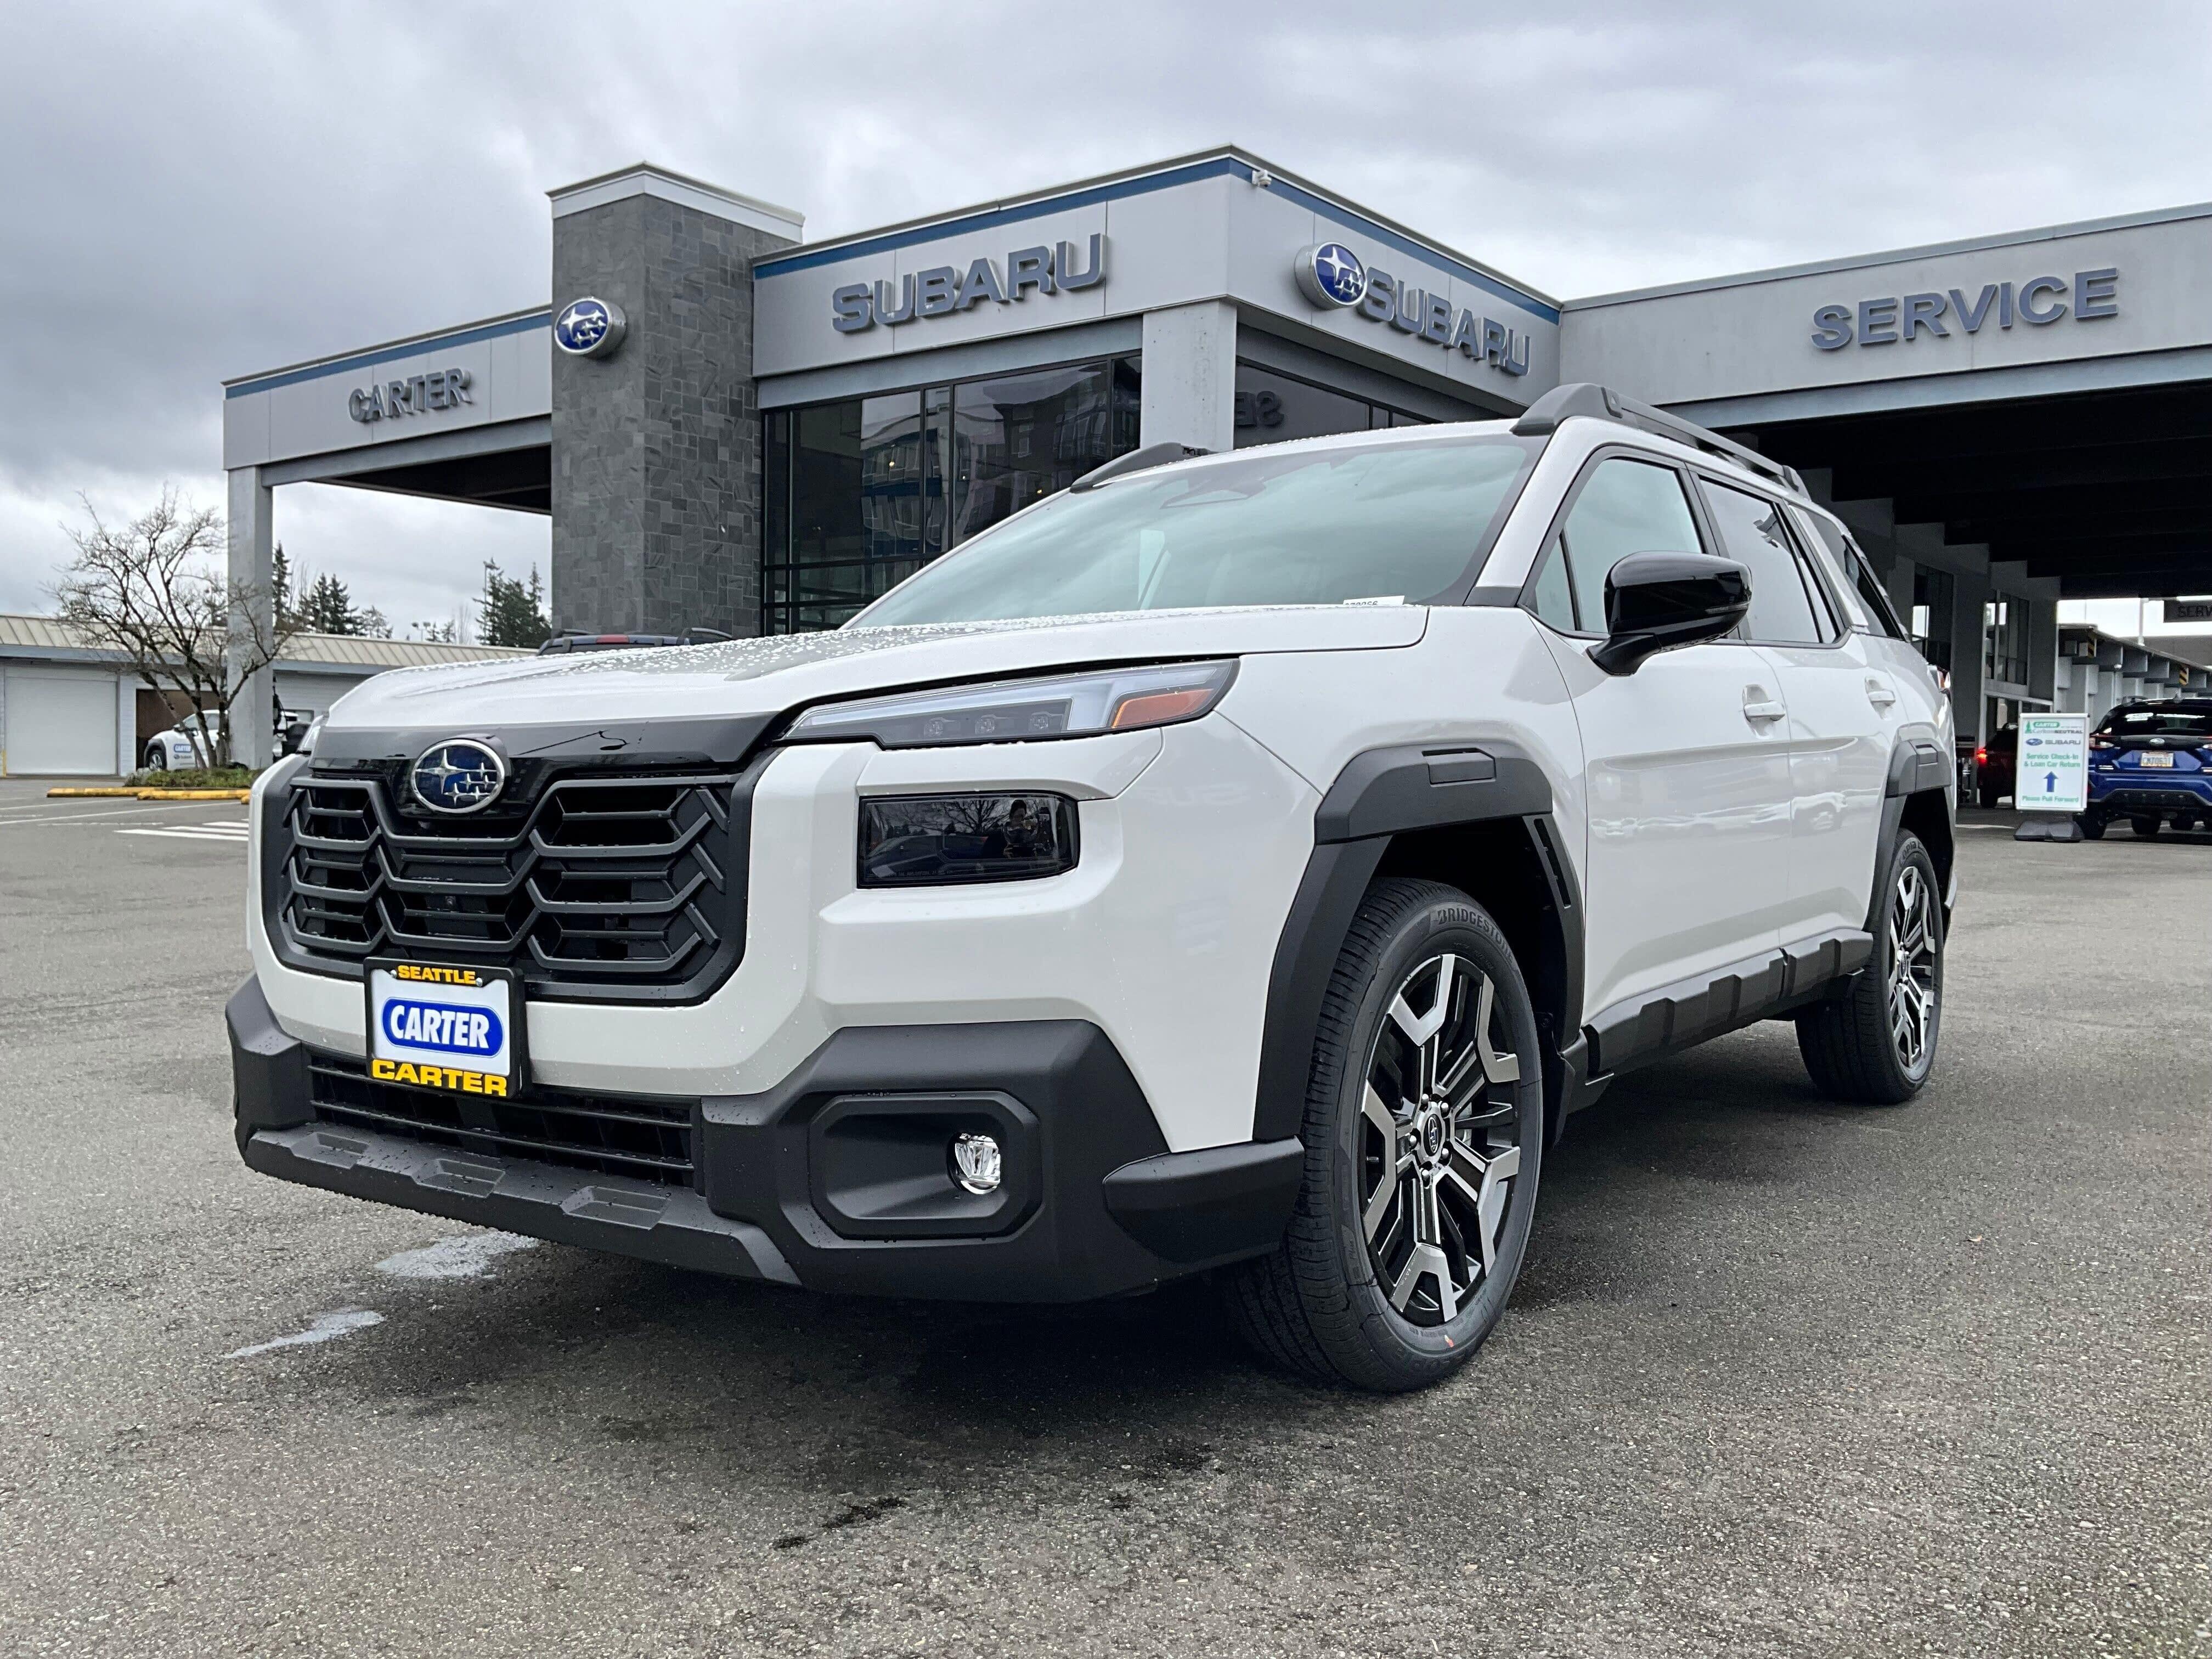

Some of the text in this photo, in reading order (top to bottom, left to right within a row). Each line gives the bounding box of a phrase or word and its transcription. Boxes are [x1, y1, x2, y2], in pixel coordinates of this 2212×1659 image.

[831, 233, 1107, 334] SUBARU
[1810, 267, 2119, 351] SERVICE
[1362, 267, 1531, 376] SUBARU
[348, 368, 472, 422] CARTER
[1437, 907, 1514, 963] BRIDGESTONE
[397, 964, 476, 985] SEATTLE
[390, 1004, 489, 1049] CARTER
[371, 1058, 507, 1097] CARTER
